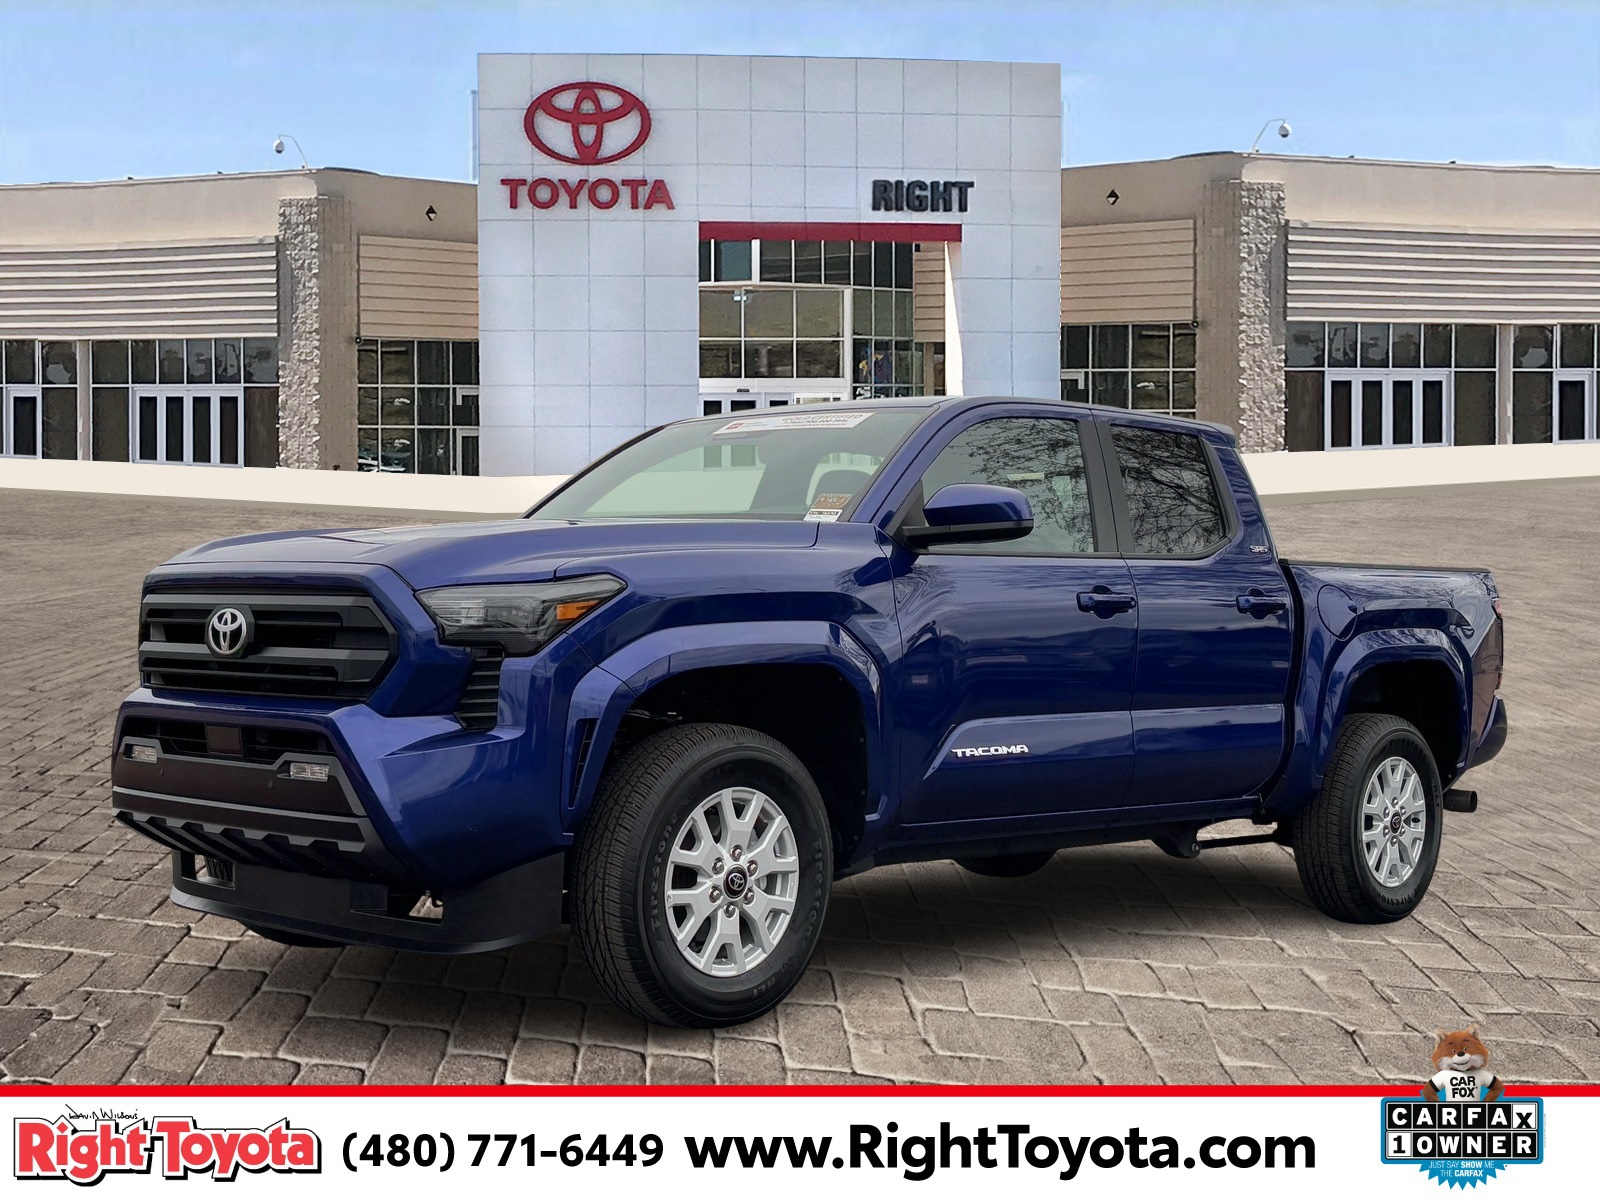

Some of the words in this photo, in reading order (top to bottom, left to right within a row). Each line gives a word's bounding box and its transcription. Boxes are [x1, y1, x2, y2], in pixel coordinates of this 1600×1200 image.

[500, 178, 675, 210] TOYOTA
[871, 179, 975, 213] RIGHT
[951, 744, 1029, 758] TACOMA
